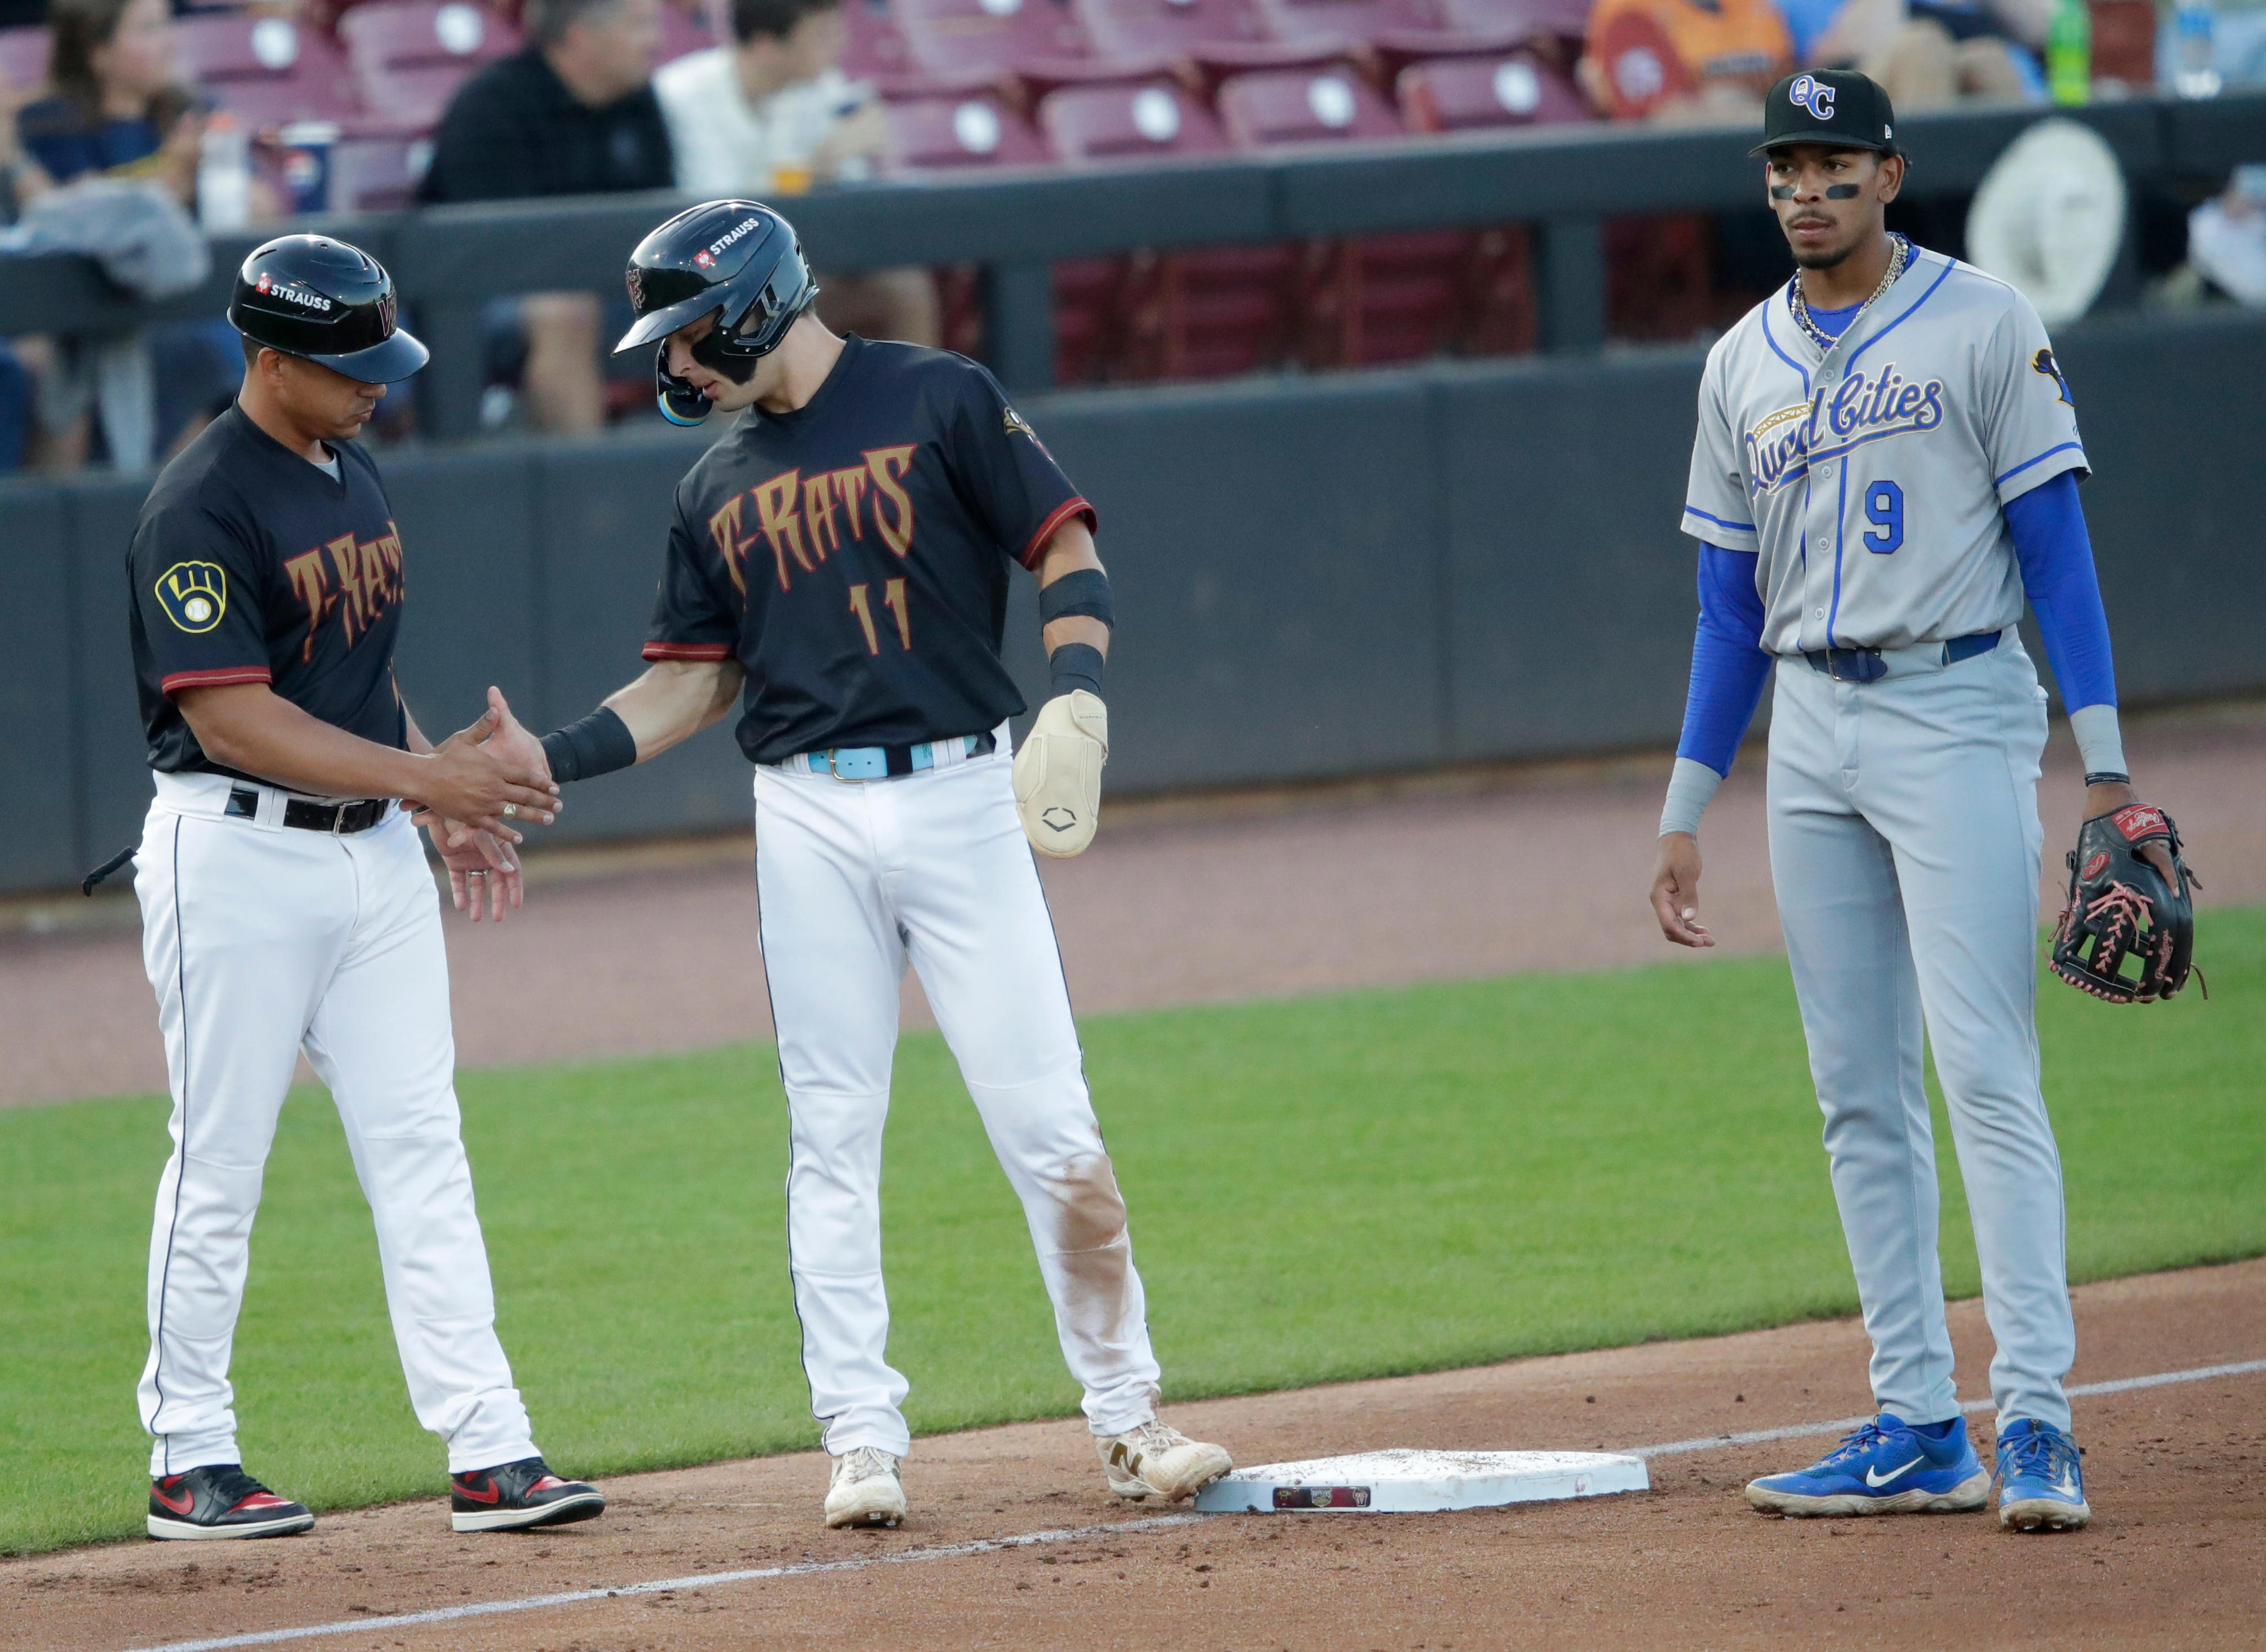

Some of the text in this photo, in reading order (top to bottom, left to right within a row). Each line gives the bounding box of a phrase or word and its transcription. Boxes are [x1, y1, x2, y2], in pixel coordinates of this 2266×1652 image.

[710, 217, 759, 255] STRAUSS
[270, 284, 331, 311] STRAUSS
[1827, 362, 1944, 438] Cities
[708, 443, 918, 612] T-RATS
[1863, 480, 1904, 554] 9
[849, 576, 912, 656] 11
